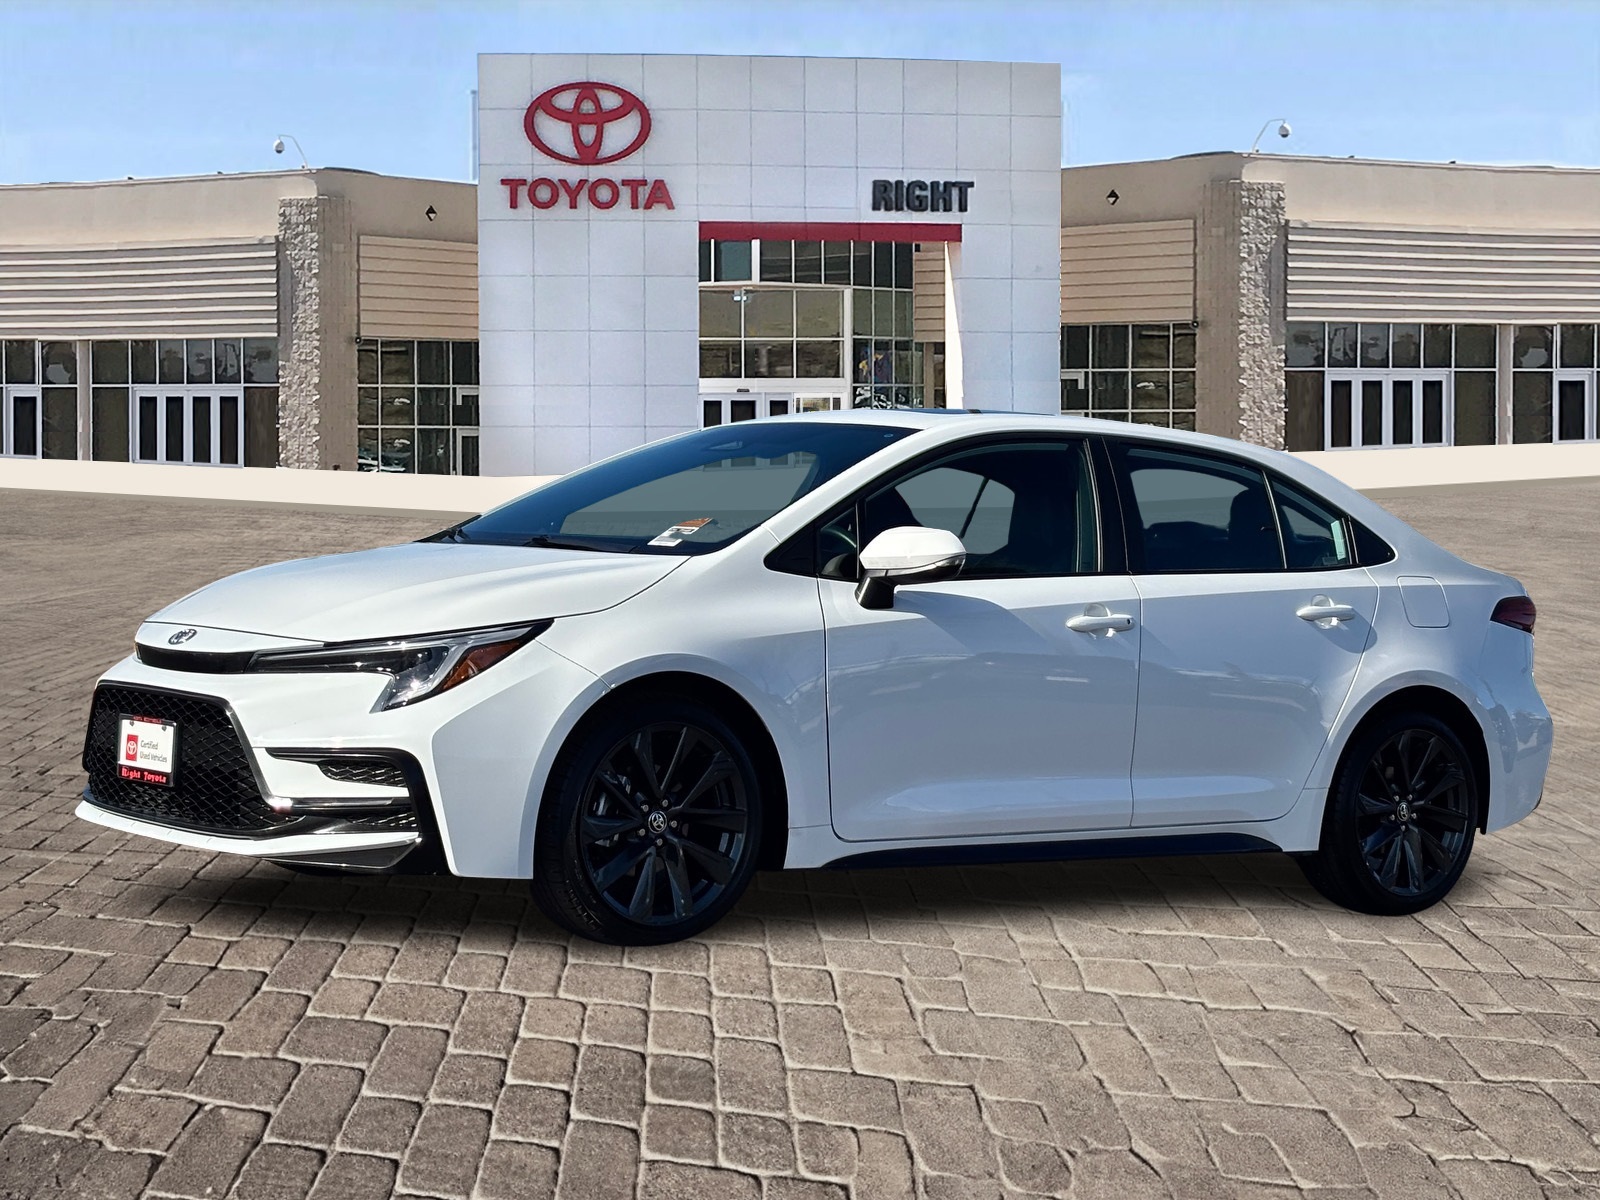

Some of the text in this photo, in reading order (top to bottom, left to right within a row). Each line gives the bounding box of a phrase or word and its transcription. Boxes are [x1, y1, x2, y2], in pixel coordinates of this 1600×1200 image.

[500, 178, 675, 210] TOYOTA
[872, 179, 975, 213] RIGHT
[140, 740, 159, 750] Certified
[139, 751, 168, 763] Used Vehicles
[121, 766, 167, 783] Right Toyota
